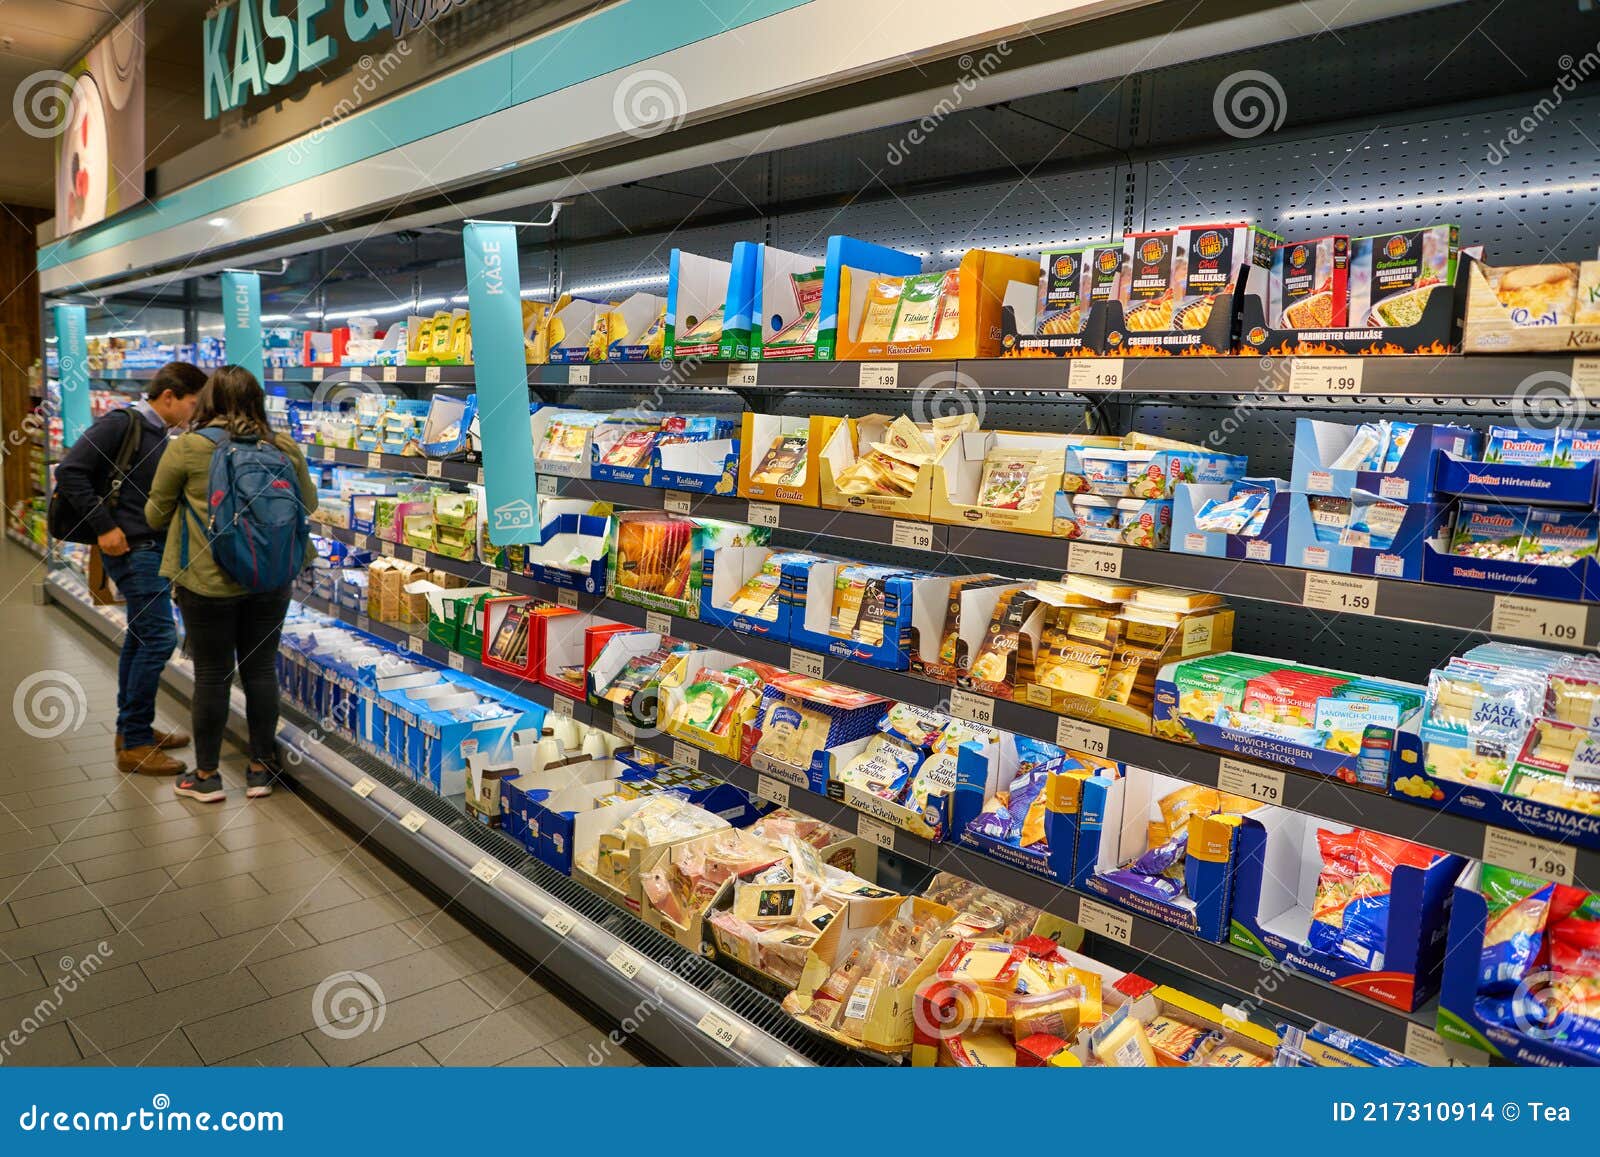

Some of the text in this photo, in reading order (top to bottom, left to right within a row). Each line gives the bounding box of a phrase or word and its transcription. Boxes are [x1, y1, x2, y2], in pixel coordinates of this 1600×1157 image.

[487, 240, 501, 295] KÄSE
[236, 284, 249, 329] MILCH
[1128, 334, 1201, 346] CREMIGER GRILLKÄSE
[1297, 329, 1383, 342] MARINIERTER GRILLKÄSE
[1567, 330, 1600, 347] Käs
[742, 375, 755, 384] 1.59
[878, 376, 895, 386] 1.99
[1095, 374, 1118, 386] 1.99
[1326, 377, 1356, 390] 1.99
[1503, 439, 1545, 452] Devina
[1572, 440, 1600, 451] Devi
[1501, 477, 1551, 489] Hirtenkäse
[775, 487, 803, 500] Gouda
[763, 515, 777, 524] 1.99
[1318, 512, 1343, 524] FETA
[1471, 513, 1514, 527] Devina
[1541, 523, 1589, 538] Devina
[912, 536, 929, 546] 1.99
[1095, 561, 1117, 573] 1.99
[1487, 571, 1538, 585] Hirtenkäse
[1340, 594, 1370, 609] 1.59
[1539, 622, 1577, 639] 1.09
[1060, 646, 1102, 667] Gouda
[806, 665, 821, 675] 1.65
[971, 708, 989, 721] 1.69
[1481, 702, 1516, 717] KÄSE
[1473, 712, 1520, 729] SNACK
[1083, 738, 1104, 752] 1.79
[1220, 731, 1313, 760] SANDWICH-SCHEIBEN
[1233, 744, 1296, 766] & KÄSE-STICKS
[1251, 783, 1277, 799] 1.79
[850, 796, 904, 826] Zarte Scheiben
[875, 833, 892, 846] 1.99
[1529, 856, 1566, 877] 1.99
[1119, 896, 1162, 919] Mozzarella
[1170, 909, 1189, 920] und
[1105, 922, 1127, 939] 1.75
[1286, 951, 1337, 978] Reibekäse
[715, 1027, 733, 1043] 9.99
